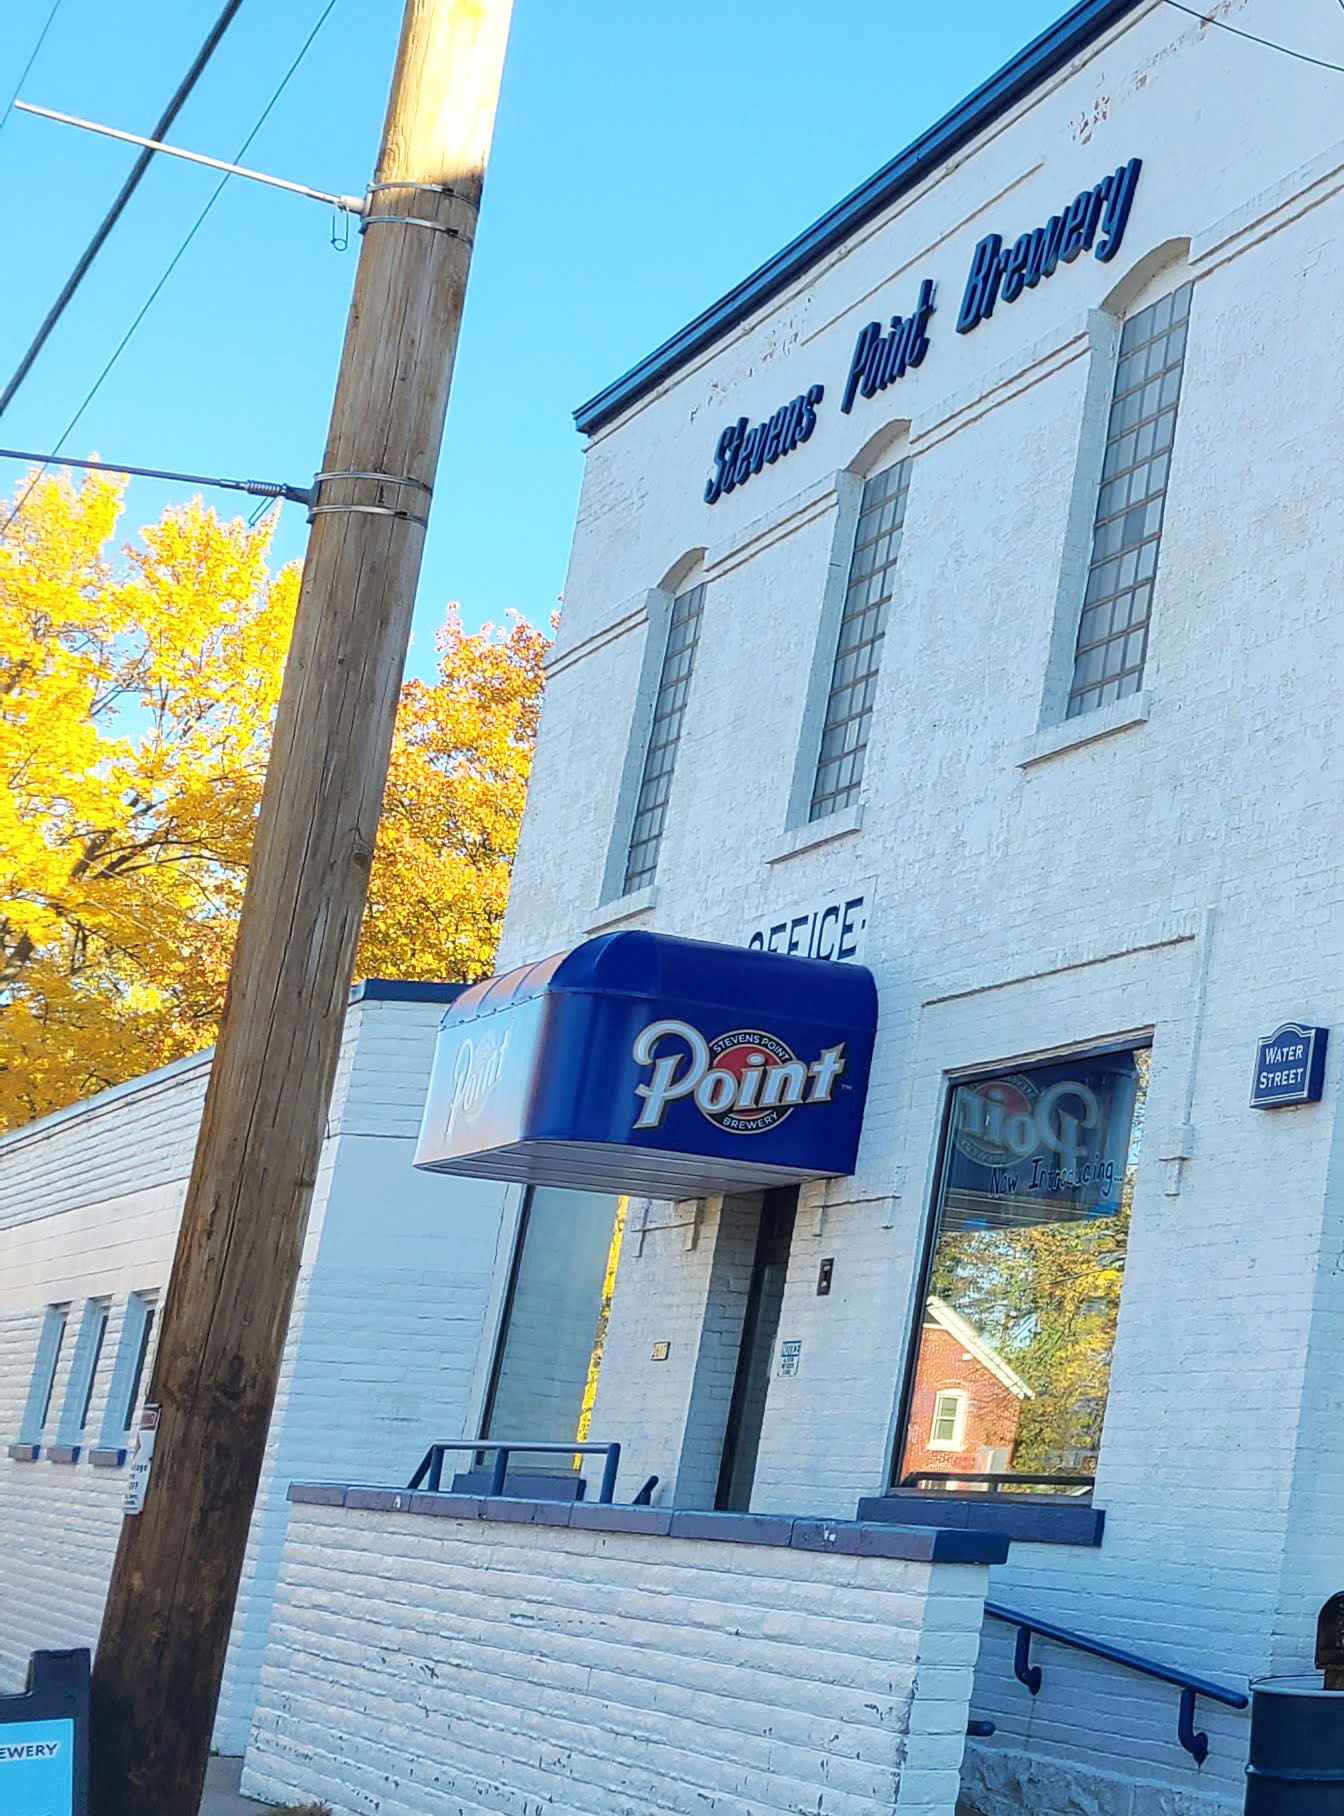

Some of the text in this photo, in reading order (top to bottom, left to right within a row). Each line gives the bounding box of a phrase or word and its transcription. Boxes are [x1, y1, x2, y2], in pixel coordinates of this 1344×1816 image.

[704, 157, 1142, 504] Stevens Point Brewery
[713, 1034, 790, 1062] STEVENS POINT
[1265, 1045, 1303, 1065] WATER
[632, 1019, 847, 1129] Point
[1259, 1068, 1303, 1089] STREET
[722, 1111, 779, 1130] BREWERY
[989, 1167, 1019, 1197] Now
